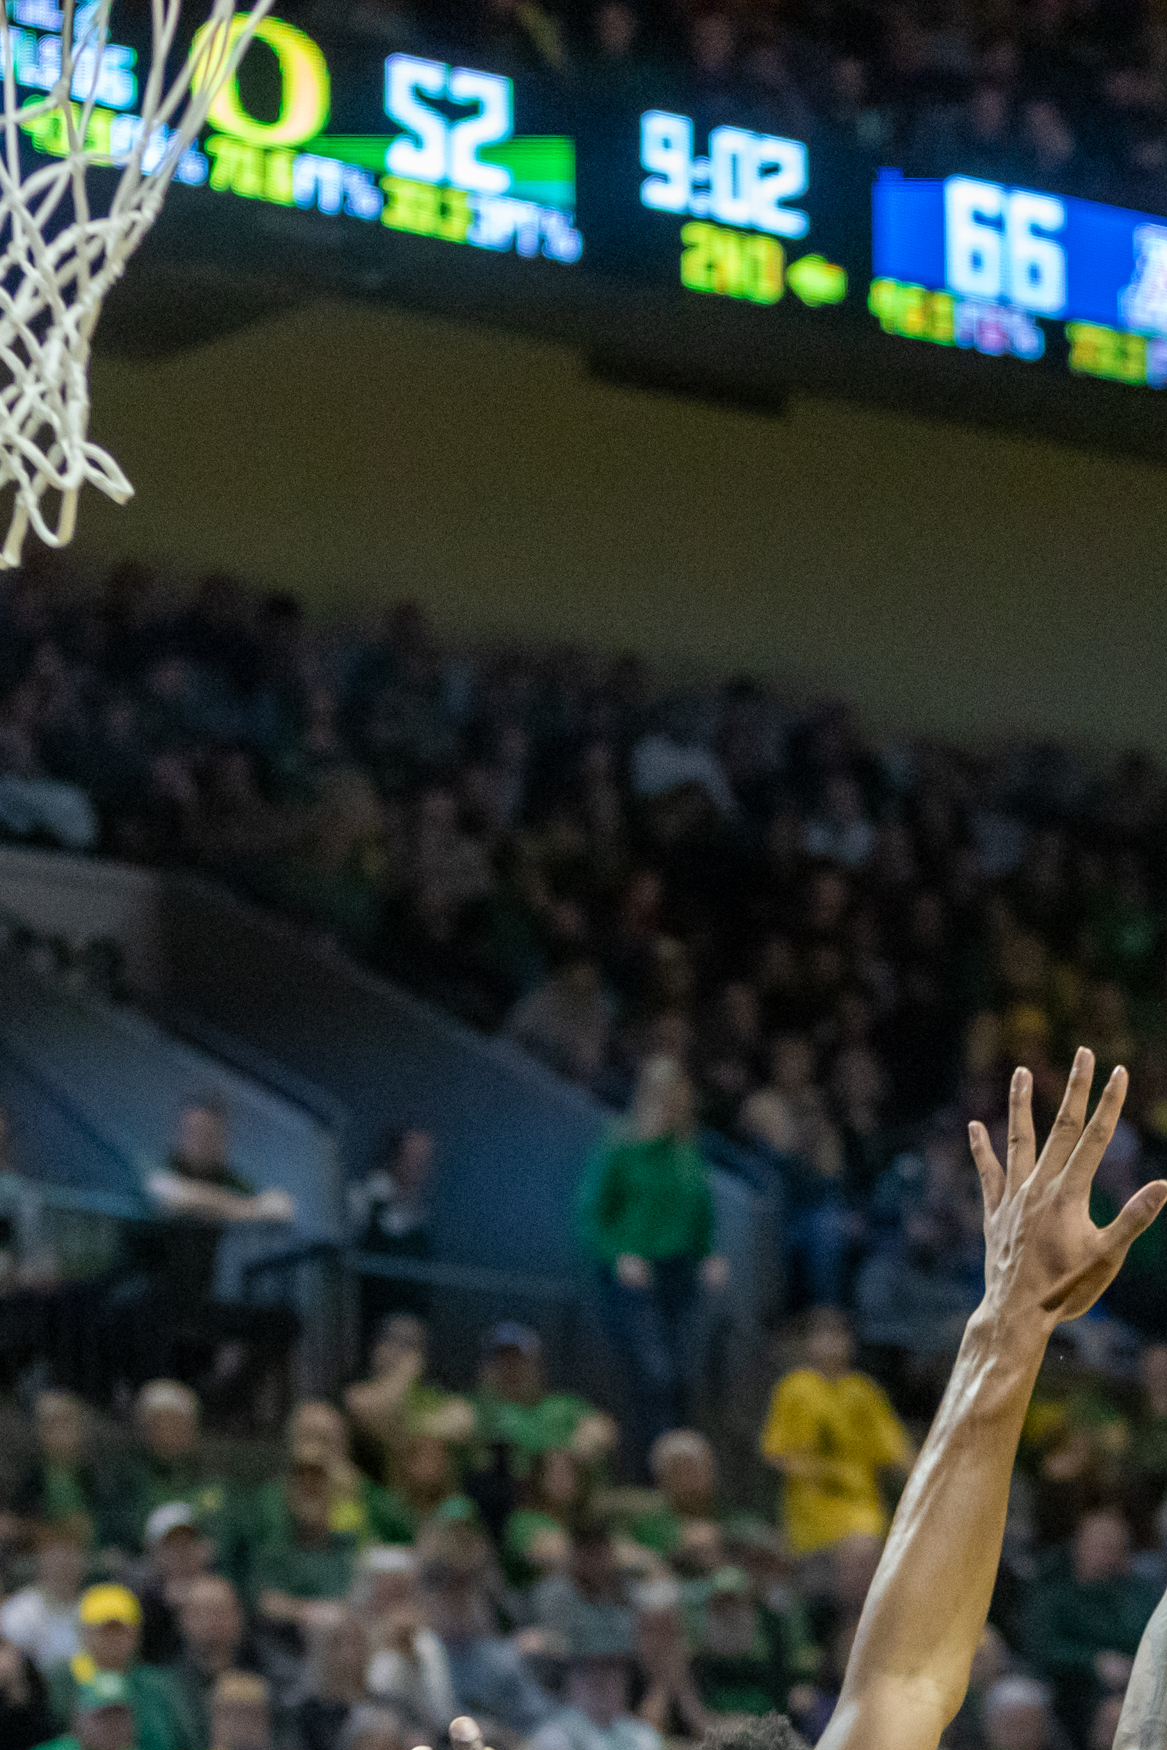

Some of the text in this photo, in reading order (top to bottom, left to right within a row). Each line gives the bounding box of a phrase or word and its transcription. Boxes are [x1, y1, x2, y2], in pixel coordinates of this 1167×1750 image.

[384, 52, 514, 196] 52
[640, 110, 810, 240] 9:02
[945, 174, 1067, 320] 66
